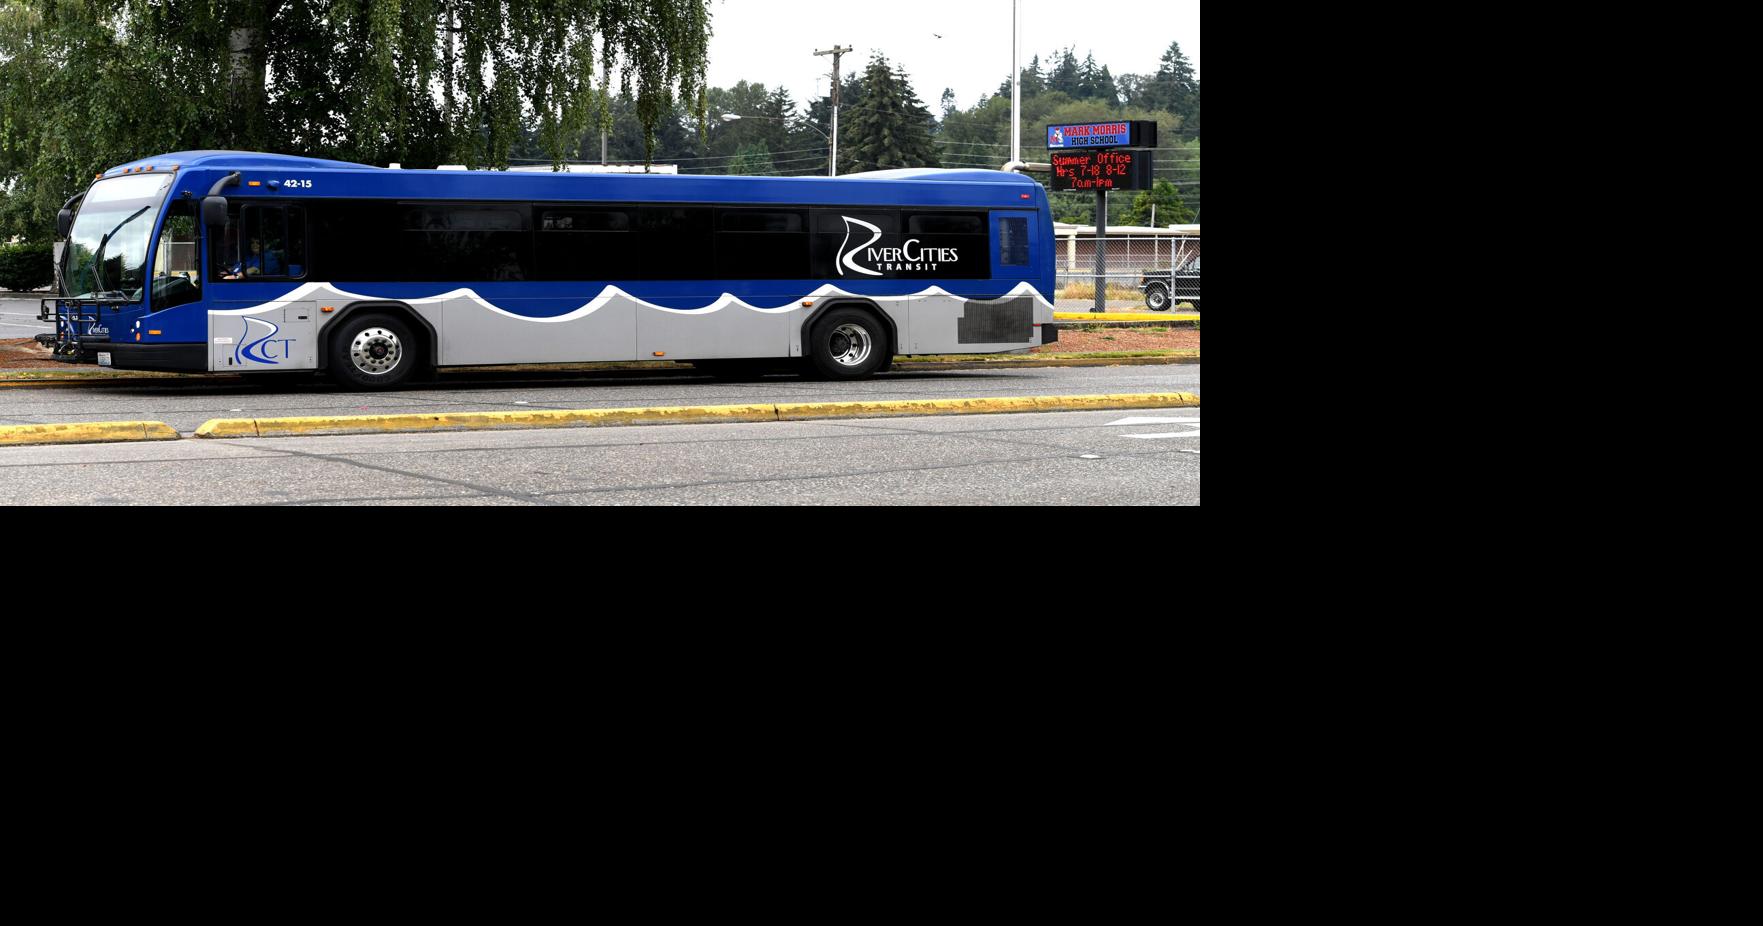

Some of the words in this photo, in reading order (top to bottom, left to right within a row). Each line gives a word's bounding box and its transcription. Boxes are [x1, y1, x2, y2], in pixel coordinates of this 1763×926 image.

[1064, 126, 1090, 136] MARK
[1092, 124, 1126, 135] MORRIS
[1071, 136, 1089, 146] HIGH
[1090, 135, 1118, 144] SCHOOL
[1052, 154, 1091, 166] Summer
[1097, 152, 1131, 163] Office
[1056, 166, 1075, 177] Hrs
[1081, 165, 1100, 176] 7-18
[1106, 164, 1126, 175] 8-12
[283, 179, 313, 188] 42-15
[1071, 176, 1113, 188] 7am-1pm
[876, 263, 937, 271] TRANSIT
